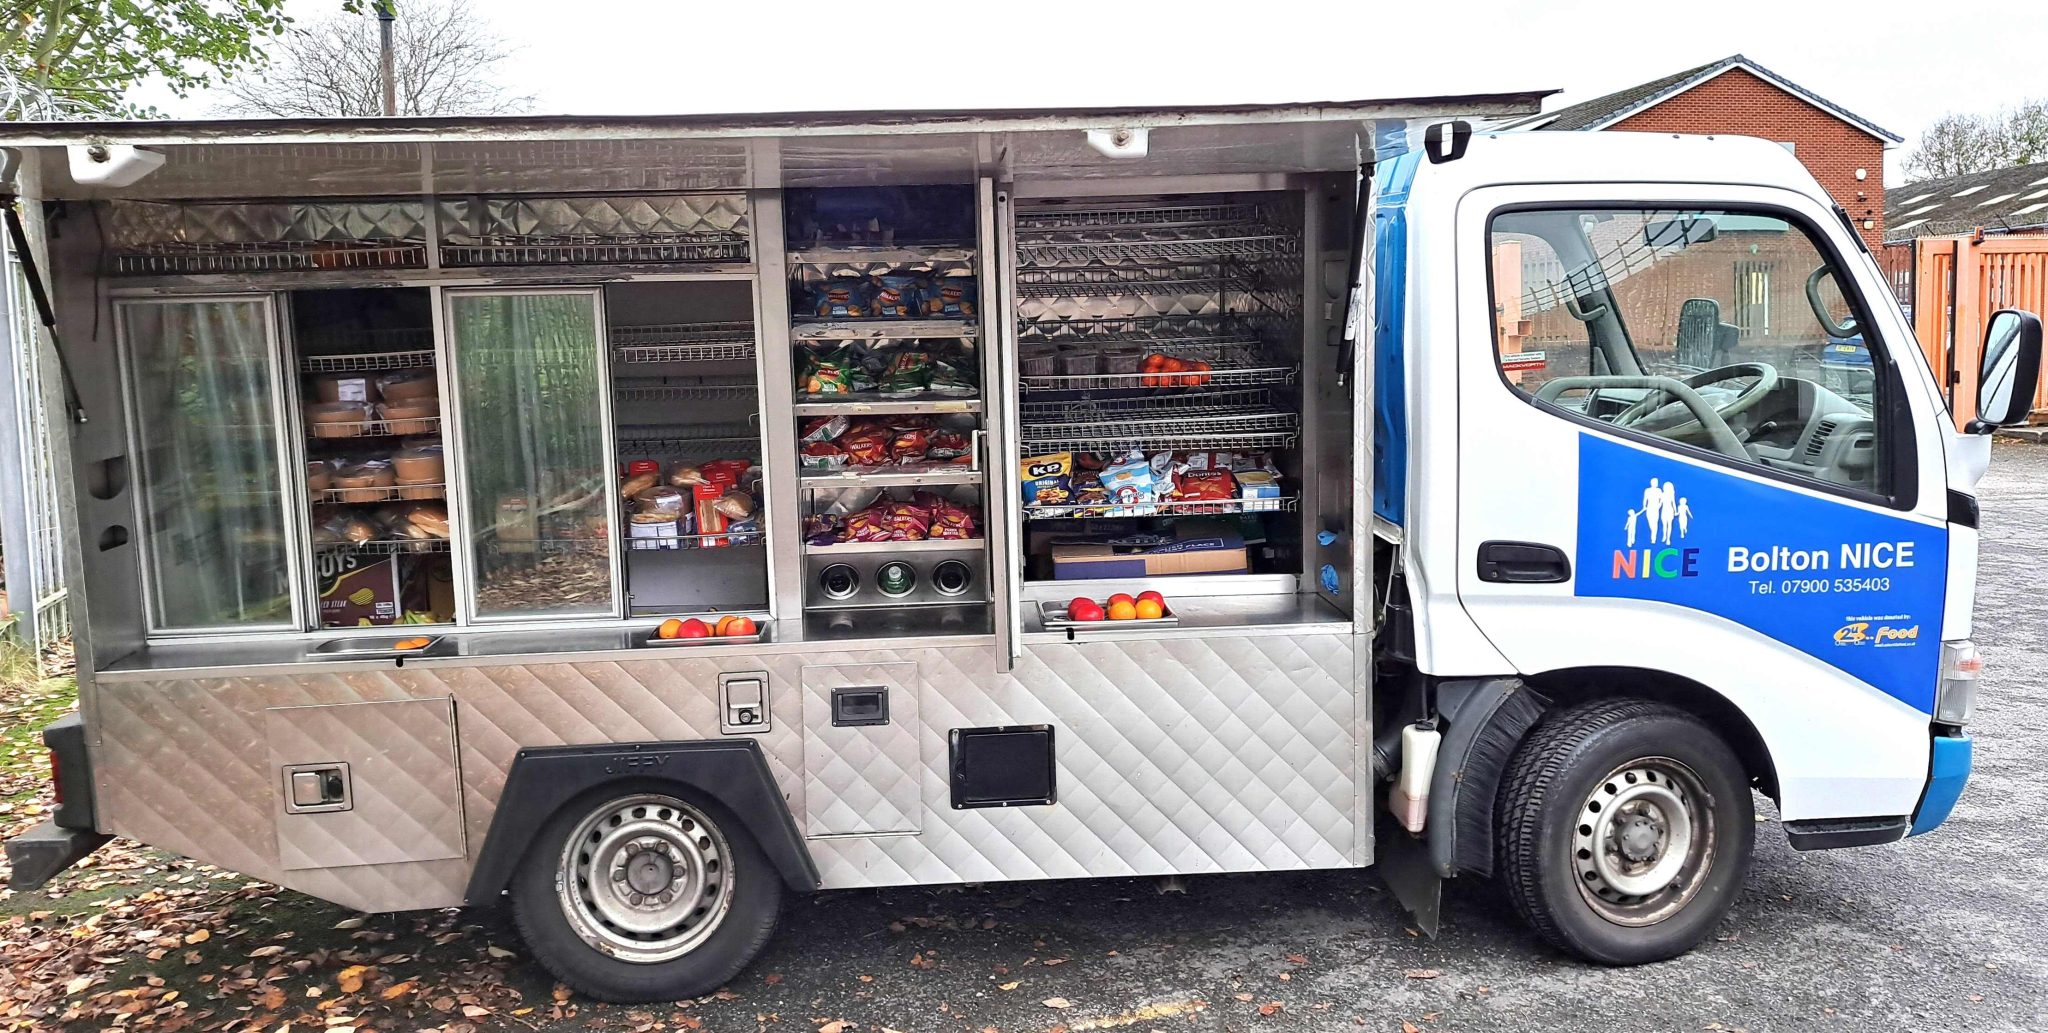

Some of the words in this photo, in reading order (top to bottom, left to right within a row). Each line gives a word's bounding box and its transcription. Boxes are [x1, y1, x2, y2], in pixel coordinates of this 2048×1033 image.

[1032, 462, 1060, 476] KP
[1611, 547, 1700, 579] NICE
[1727, 545, 1829, 573] Bolton
[1839, 542, 1915, 569] NICE
[1749, 580, 1776, 595] Tel.
[1781, 579, 1829, 594] 07900
[1834, 577, 1890, 592] 535403
[1874, 624, 1919, 644] Food
